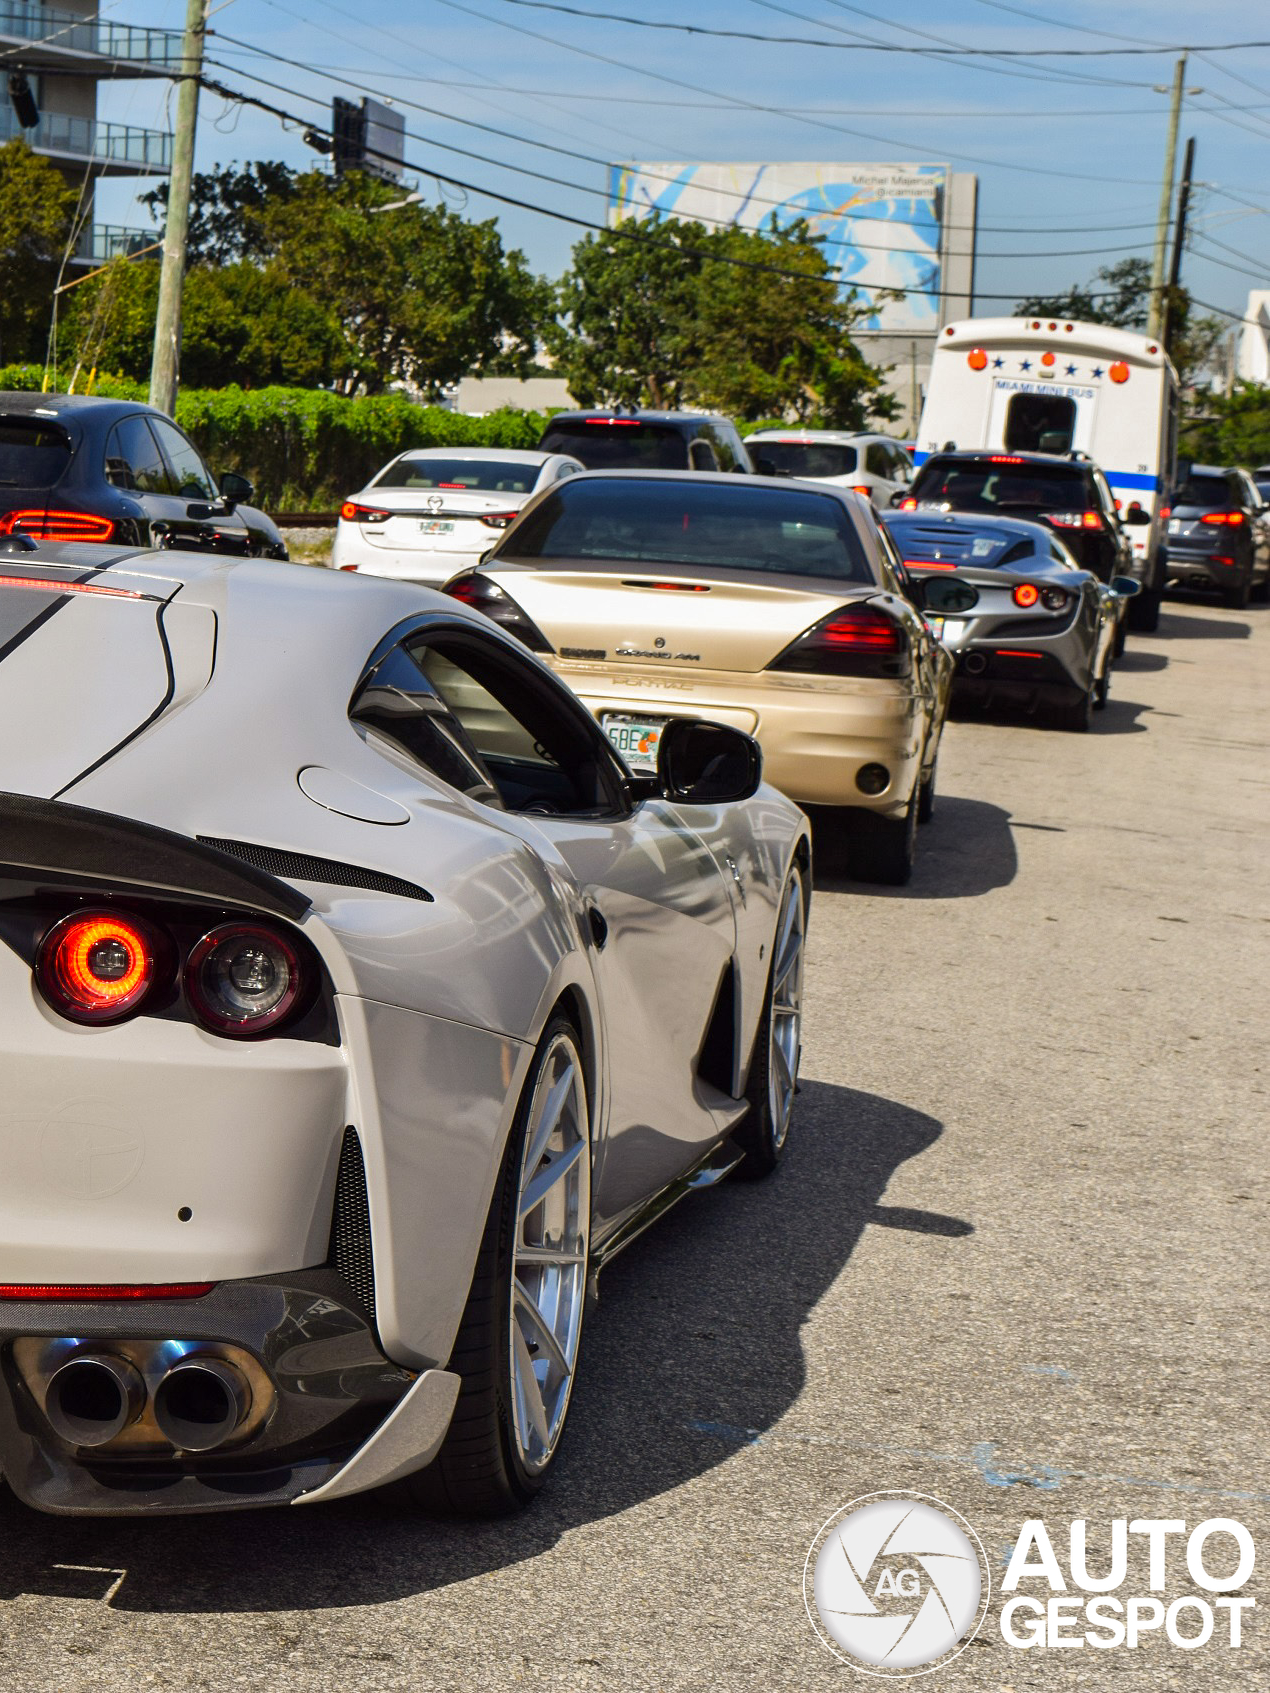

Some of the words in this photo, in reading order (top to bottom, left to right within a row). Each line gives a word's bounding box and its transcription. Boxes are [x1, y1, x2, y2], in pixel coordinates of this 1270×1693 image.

[996, 381, 1033, 393] MIAMI
[1036, 385, 1063, 395] MINI
[1067, 388, 1094, 398] BUS
[674, 653, 700, 661] AM
[612, 678, 694, 691] PONTIAC
